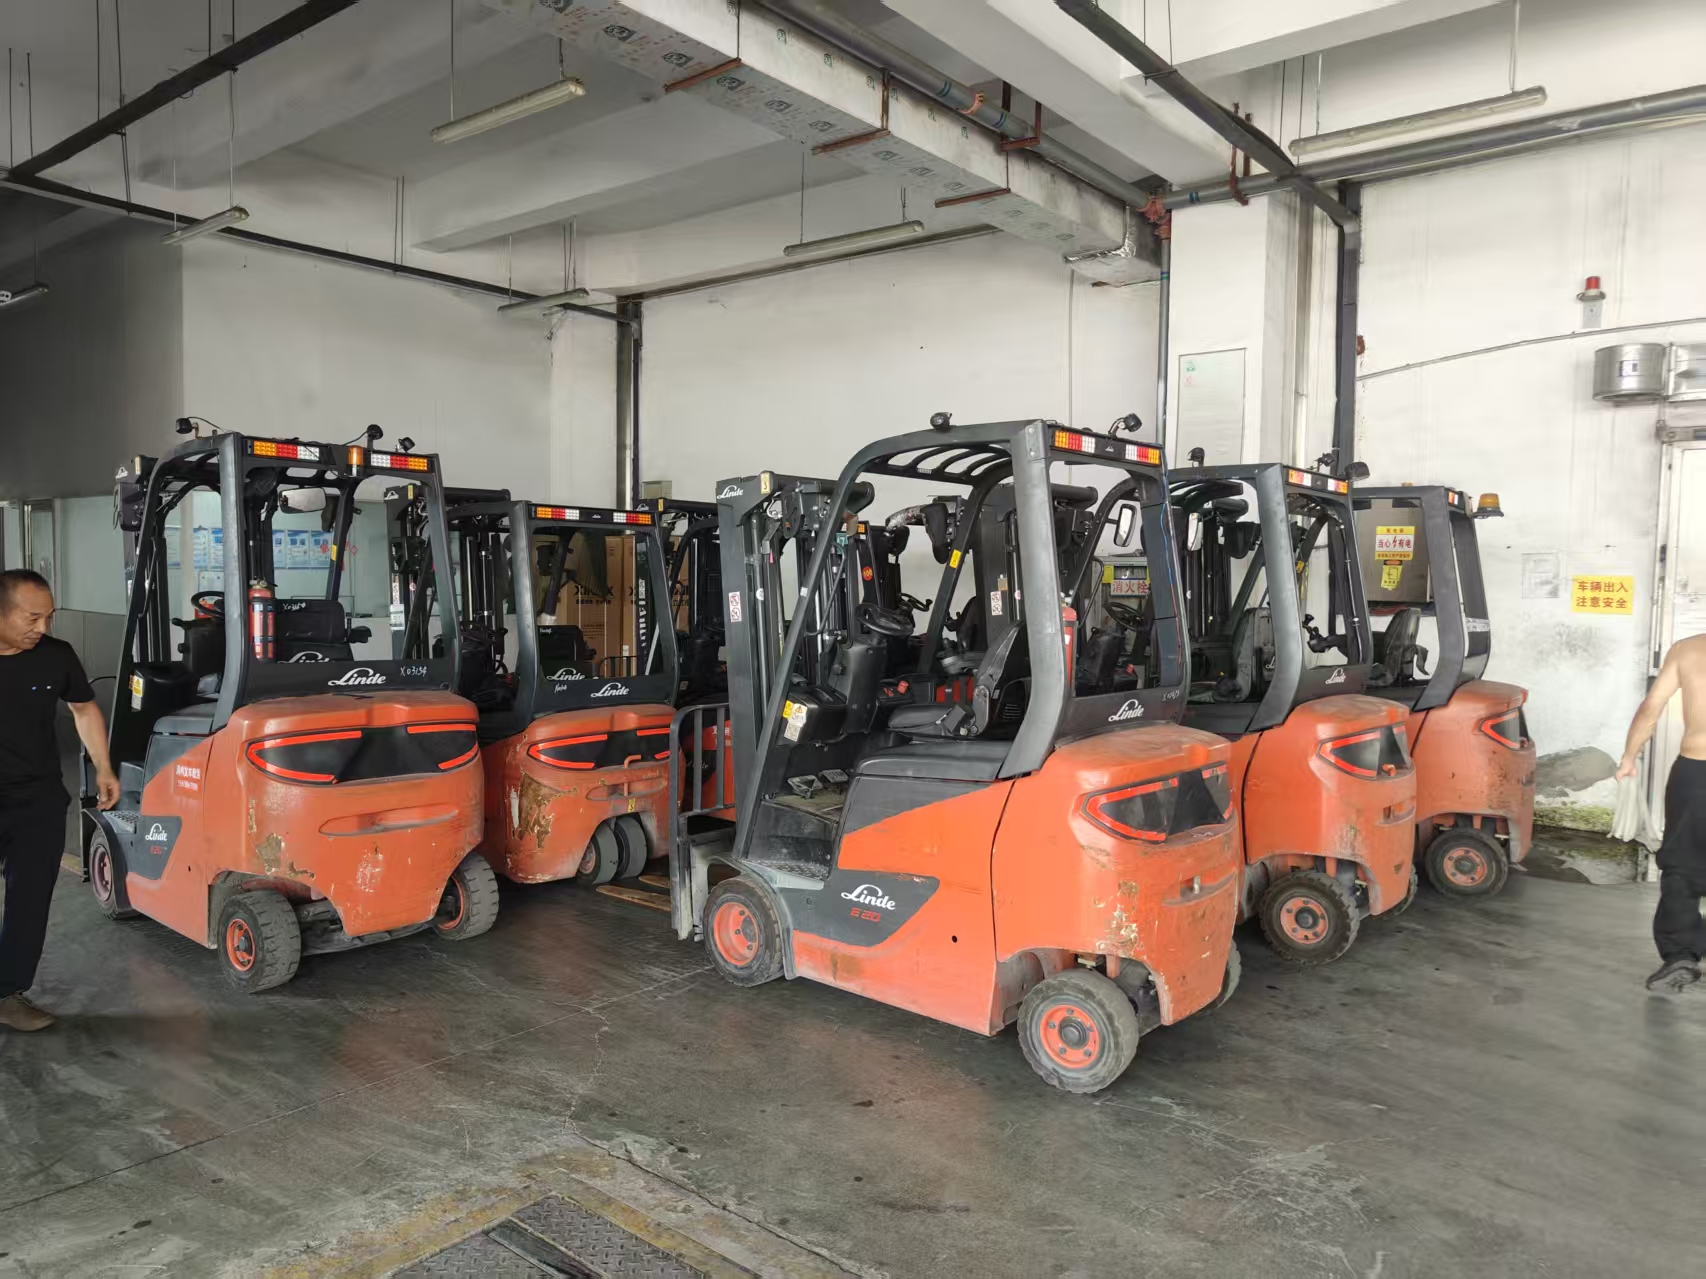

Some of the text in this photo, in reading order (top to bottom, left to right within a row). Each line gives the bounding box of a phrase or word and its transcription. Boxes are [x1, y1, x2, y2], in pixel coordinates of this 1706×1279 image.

[717, 485, 744, 499] Linde
[1577, 581, 1629, 593] 车辆出入
[1575, 596, 1628, 609] 注意安全
[327, 667, 387, 686] Linde
[590, 682, 630, 698] Linde
[1107, 699, 1145, 722] Linde
[145, 823, 168, 841] Linde
[840, 884, 896, 910] Linde
